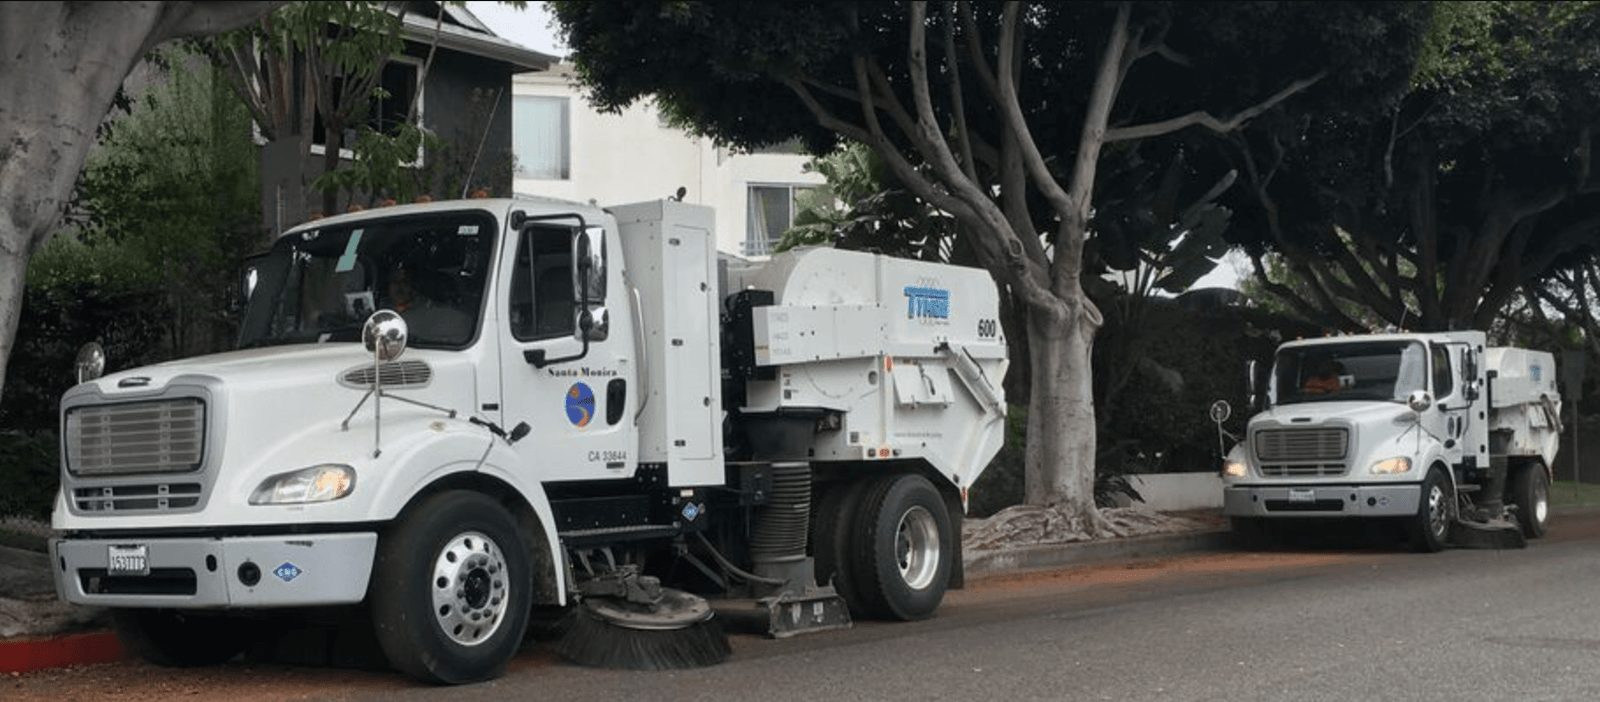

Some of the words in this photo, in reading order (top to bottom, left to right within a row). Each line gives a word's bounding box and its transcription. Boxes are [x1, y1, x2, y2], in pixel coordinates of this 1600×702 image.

[977, 318, 996, 338] 600
[548, 366, 578, 377] Santa
[581, 366, 618, 377] Monica
[588, 450, 600, 462] CA
